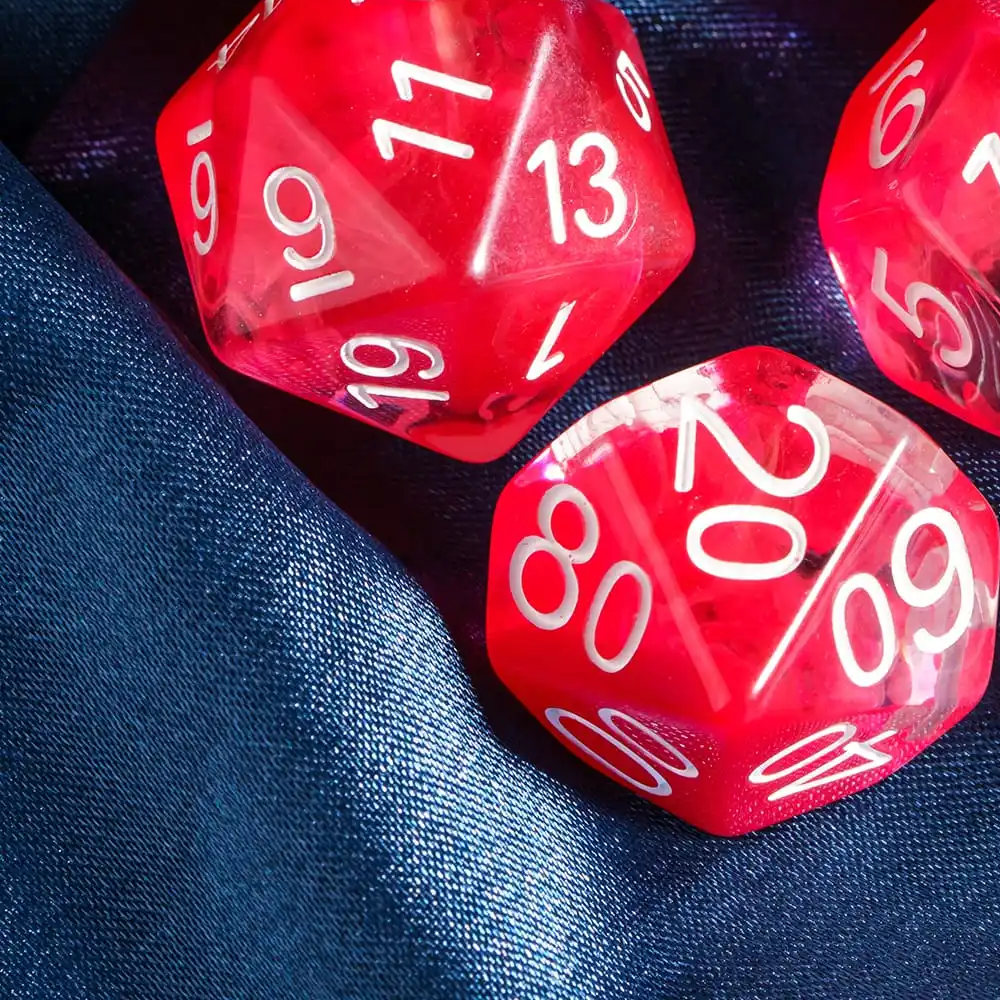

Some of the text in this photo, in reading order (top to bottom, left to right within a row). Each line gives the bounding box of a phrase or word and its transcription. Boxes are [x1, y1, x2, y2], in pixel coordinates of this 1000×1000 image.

[372, 60, 493, 160] 11
[263, 166, 355, 302] 9
[527, 132, 628, 244] 13
[525, 300, 576, 380] 1
[871, 247, 972, 368] 5
[340, 336, 450, 408] 19
[674, 399, 830, 581] 20
[509, 483, 653, 673] 80
[545, 707, 699, 796] 00
